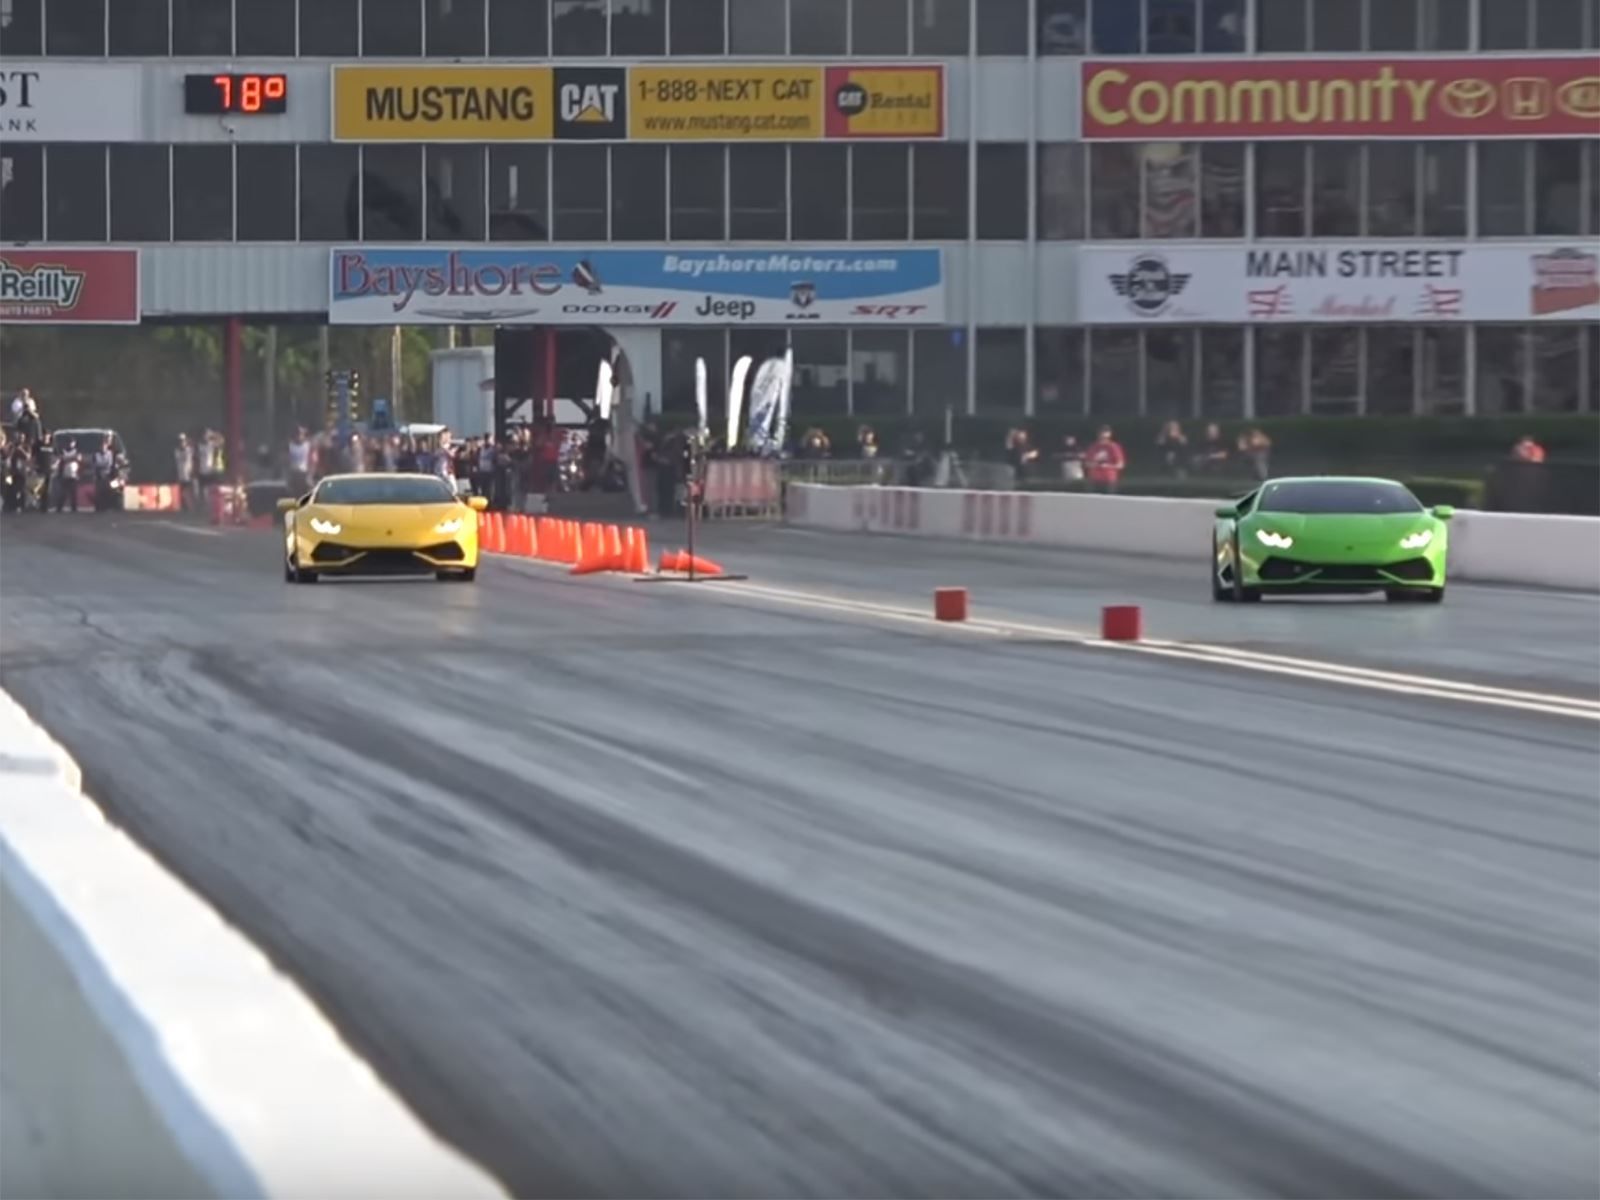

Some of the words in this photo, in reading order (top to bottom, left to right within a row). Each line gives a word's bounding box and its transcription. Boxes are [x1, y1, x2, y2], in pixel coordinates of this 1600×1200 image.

[366, 86, 533, 121] MUSTANG
[560, 84, 618, 122] CAT
[638, 79, 764, 101] 1-888-NEXT
[772, 79, 813, 100] CAT
[1086, 66, 1436, 126] Community
[663, 254, 897, 277] BayshoreMotors.com
[1246, 251, 1327, 277] MAIN
[1337, 250, 1464, 277] STREET
[338, 250, 562, 312] Bayshore
[696, 296, 756, 319] Jeep
[850, 304, 927, 318] SRT
